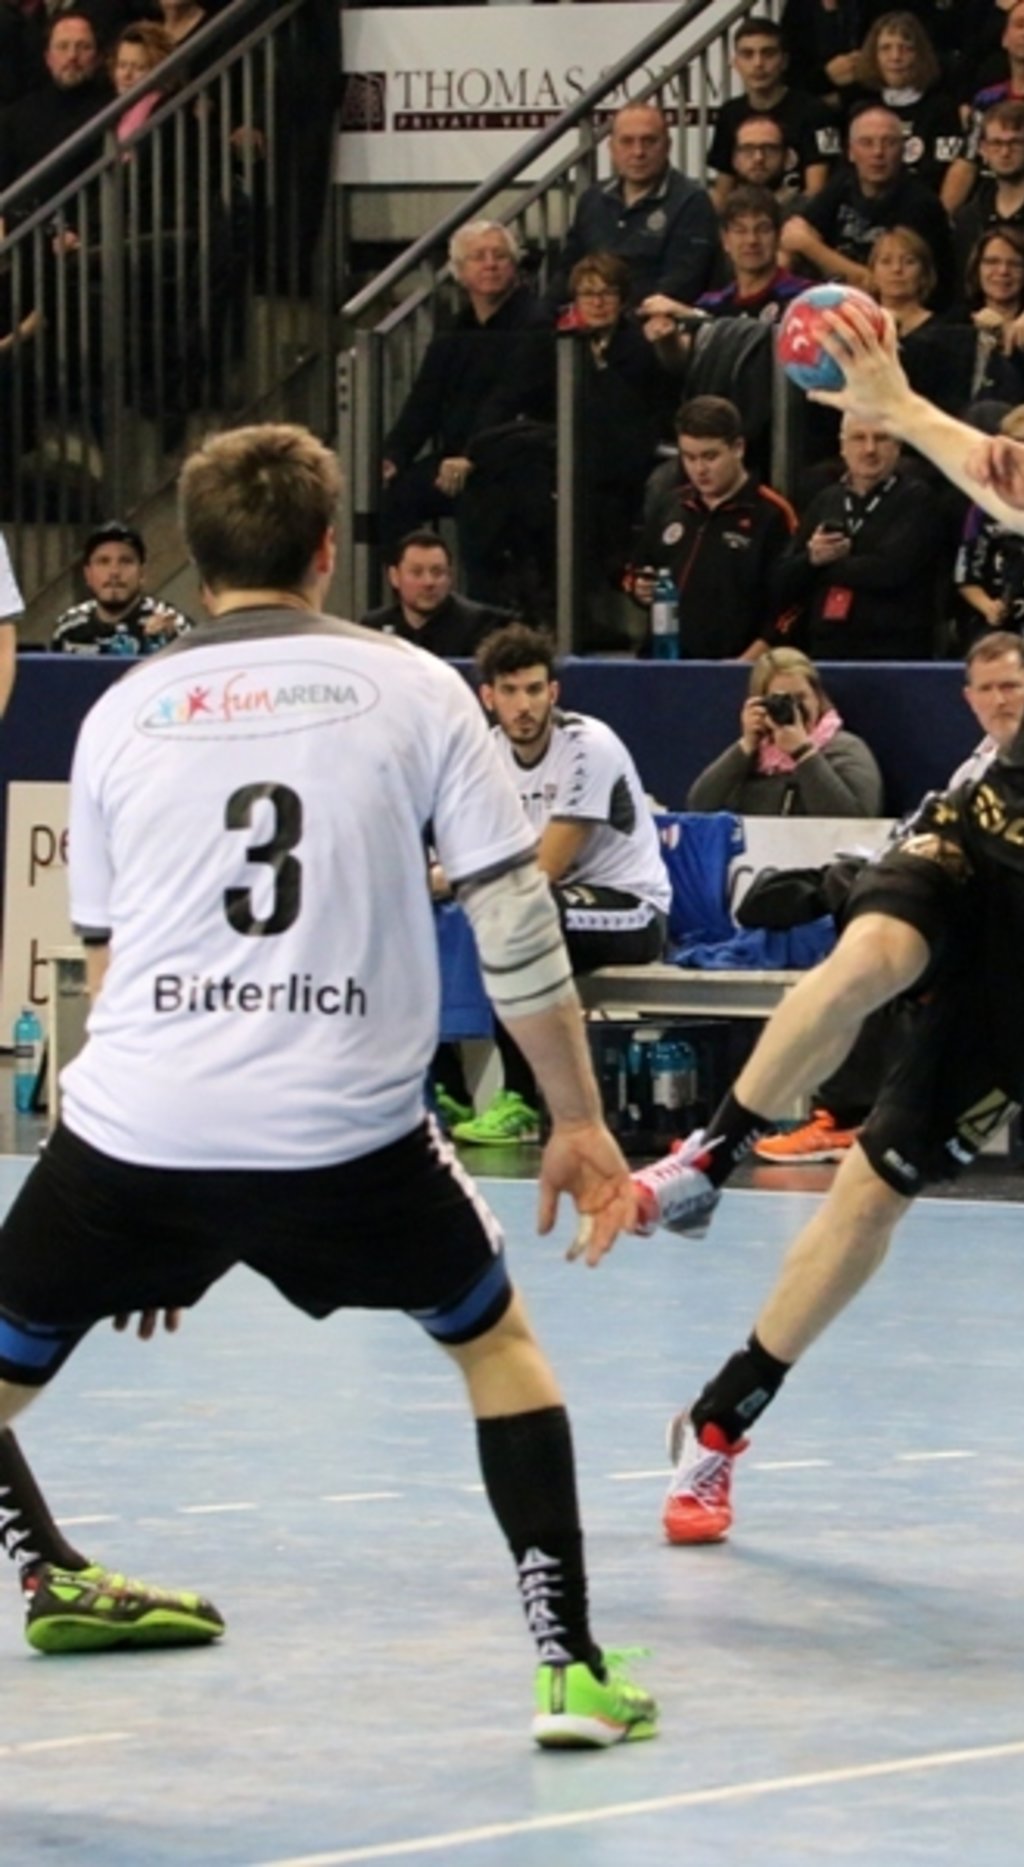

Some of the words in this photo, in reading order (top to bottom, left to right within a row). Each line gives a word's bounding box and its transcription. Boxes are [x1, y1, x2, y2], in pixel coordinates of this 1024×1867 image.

[394, 66, 587, 110] THOMAS
[399, 113, 488, 129] PRIVATE
[223, 781, 304, 938] 3
[153, 972, 368, 1017] Bitterlich
